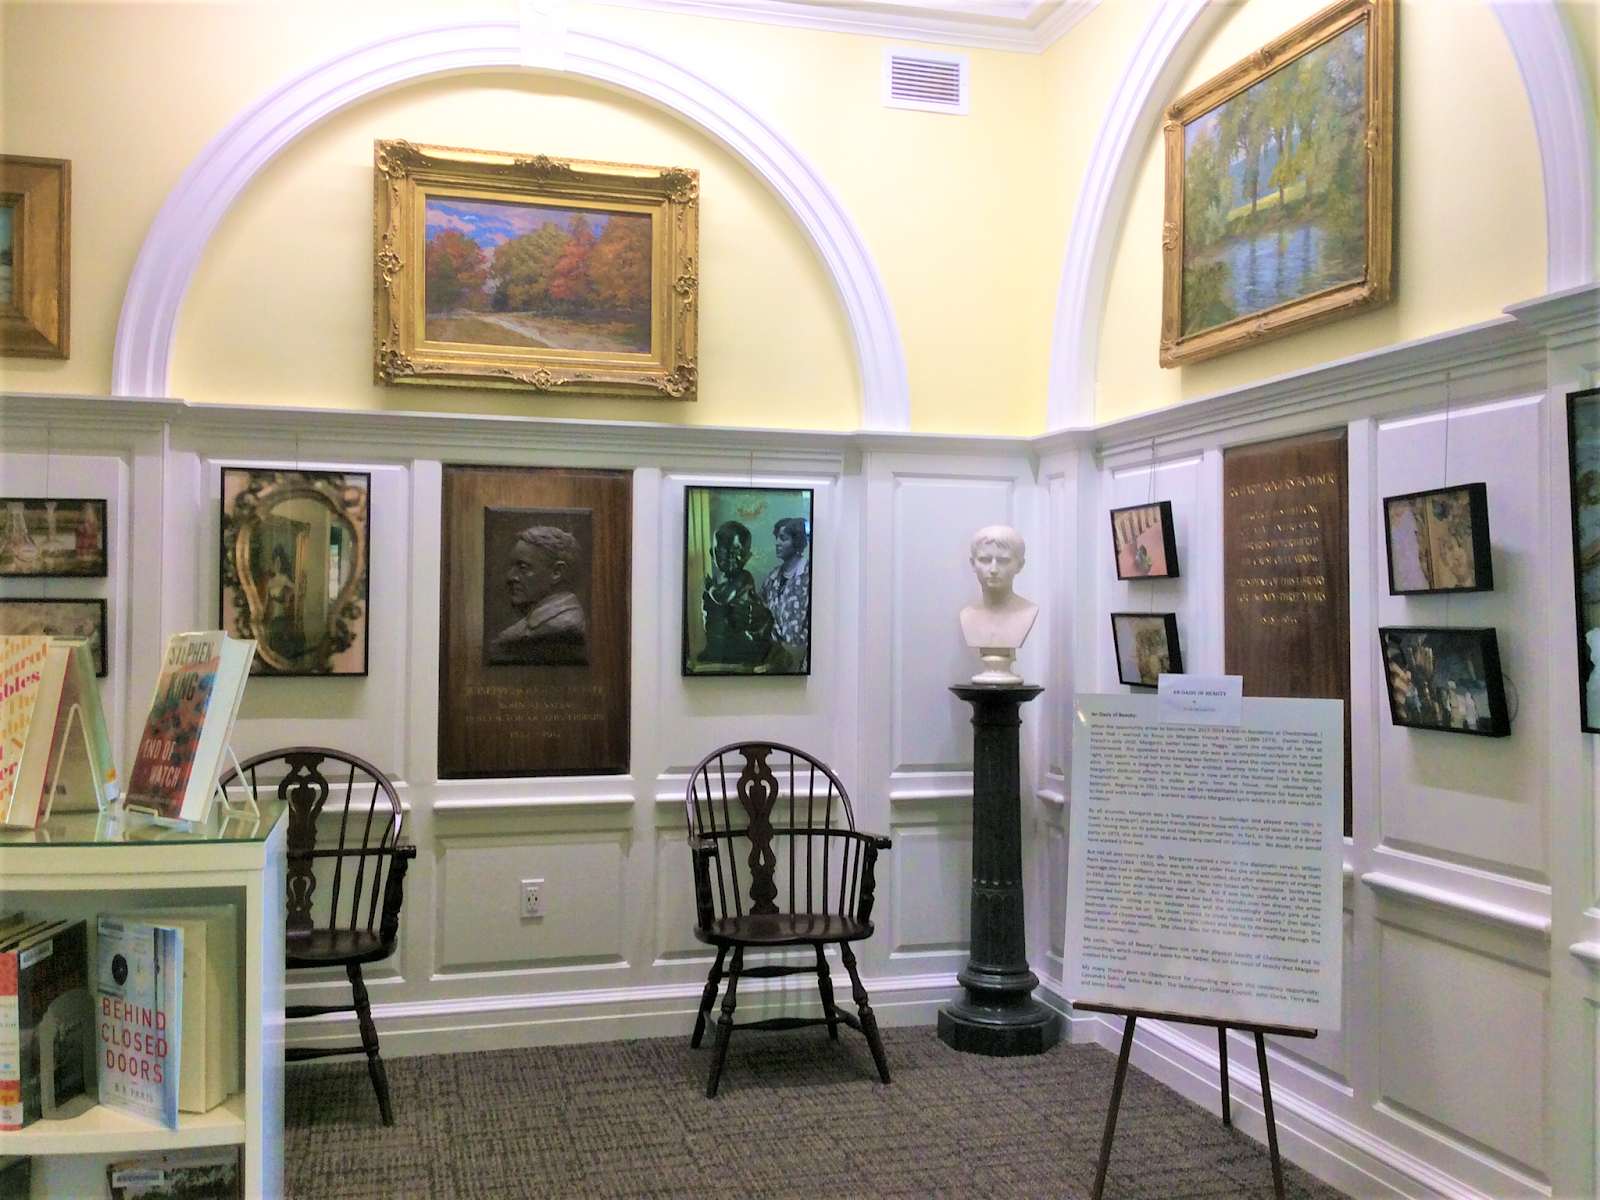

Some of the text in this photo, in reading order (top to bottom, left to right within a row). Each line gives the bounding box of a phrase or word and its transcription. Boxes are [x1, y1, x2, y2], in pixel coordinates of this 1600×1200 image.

[168, 641, 214, 666] STEPHEN
[165, 672, 199, 701] KING
[142, 739, 162, 759] END
[149, 765, 182, 788] WATCH
[102, 997, 166, 1031] BEHIND
[101, 1022, 168, 1058] CLOSED
[106, 1049, 163, 1084] DOORS
